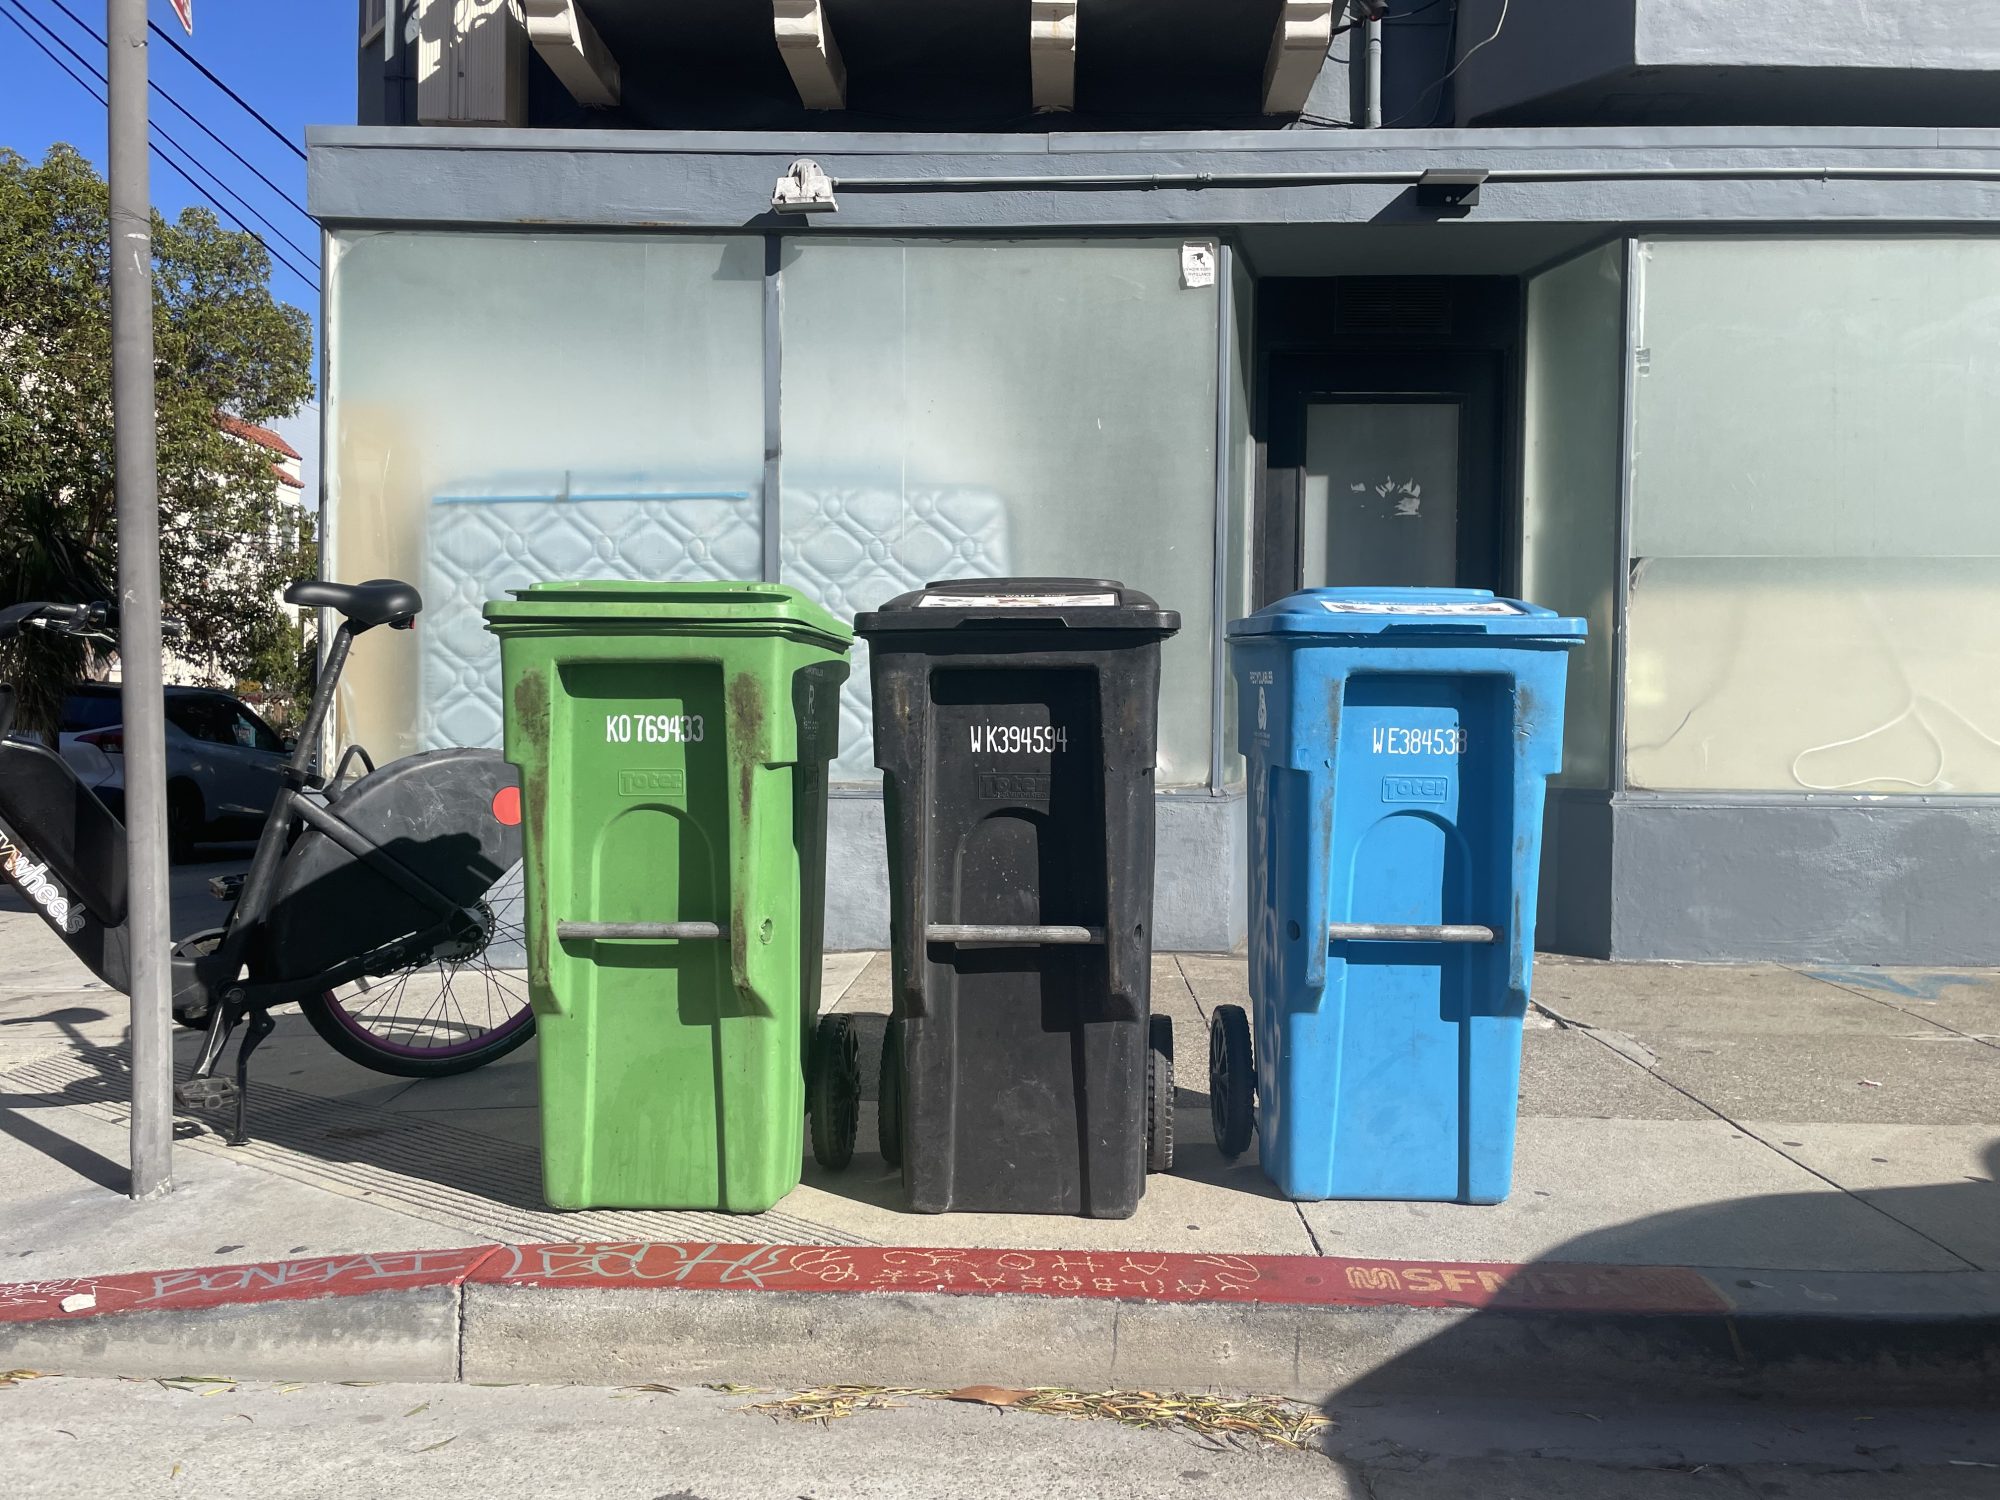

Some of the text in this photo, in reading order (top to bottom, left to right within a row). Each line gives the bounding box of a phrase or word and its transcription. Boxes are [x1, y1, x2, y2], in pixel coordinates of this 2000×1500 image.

[633, 714, 704, 743] 769433
[969, 724, 1068, 754] WK394594
[1372, 726, 1468, 755] WE384538
[1384, 777, 1445, 801] Toter
